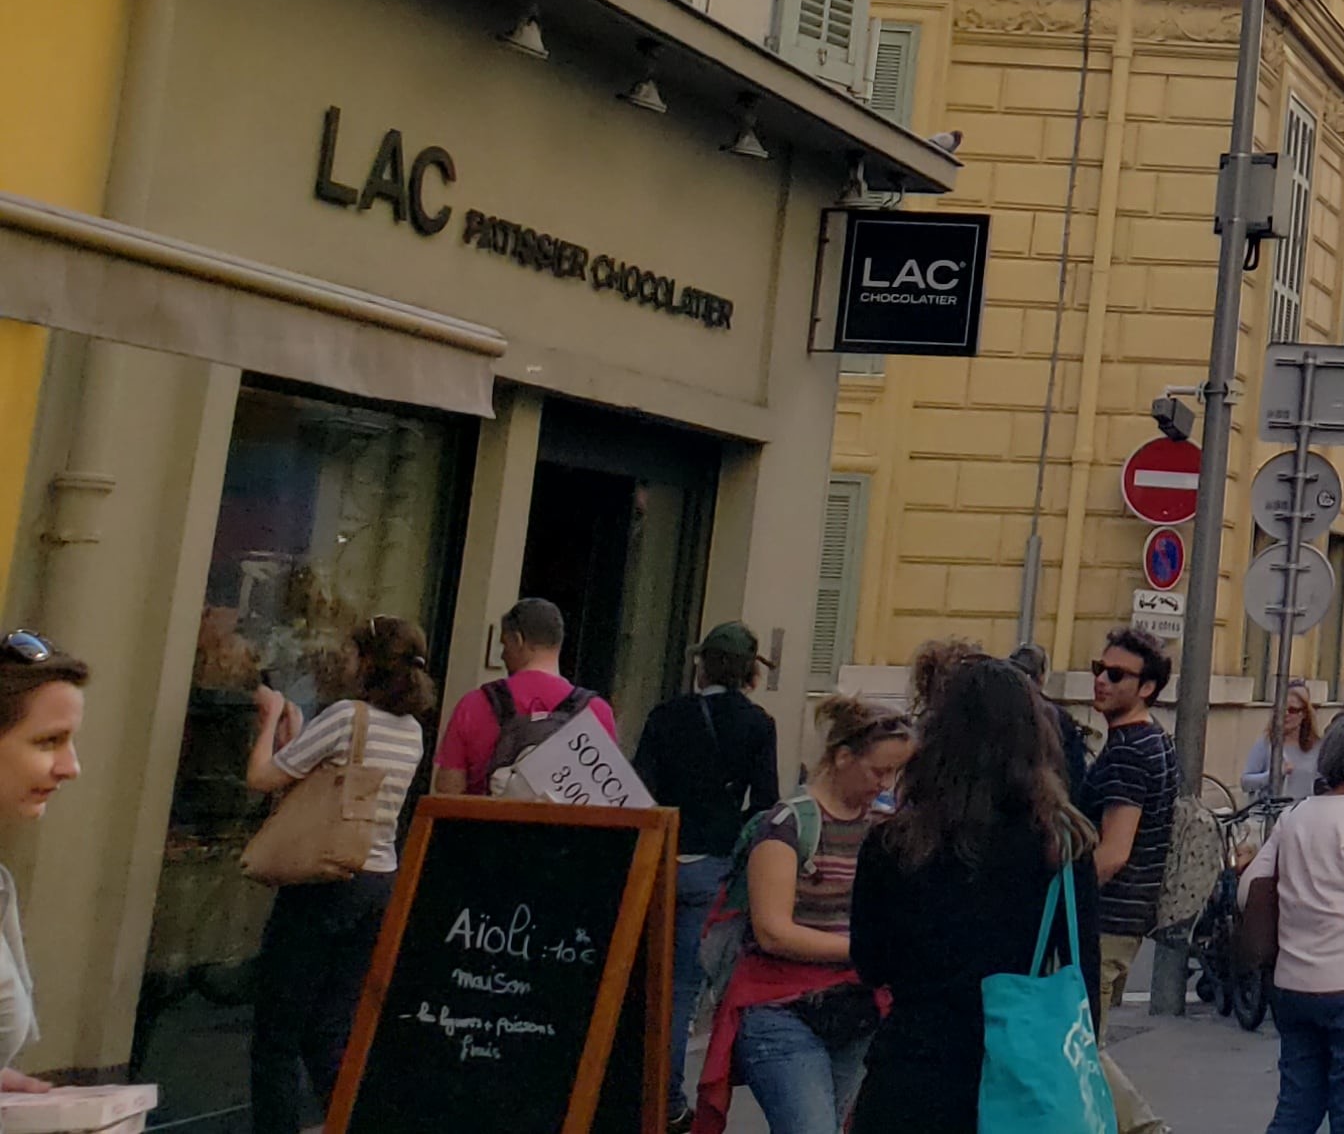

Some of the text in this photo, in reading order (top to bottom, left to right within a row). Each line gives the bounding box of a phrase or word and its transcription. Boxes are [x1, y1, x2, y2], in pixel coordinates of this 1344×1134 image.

[315, 105, 457, 237] LAC
[590, 254, 734, 330] CHOCOLATIER
[862, 257, 961, 291] LAC
[860, 292, 958, 306] CHOCOLATIER
[445, 903, 537, 960] Aïoli
[452, 965, 531, 994] maison
